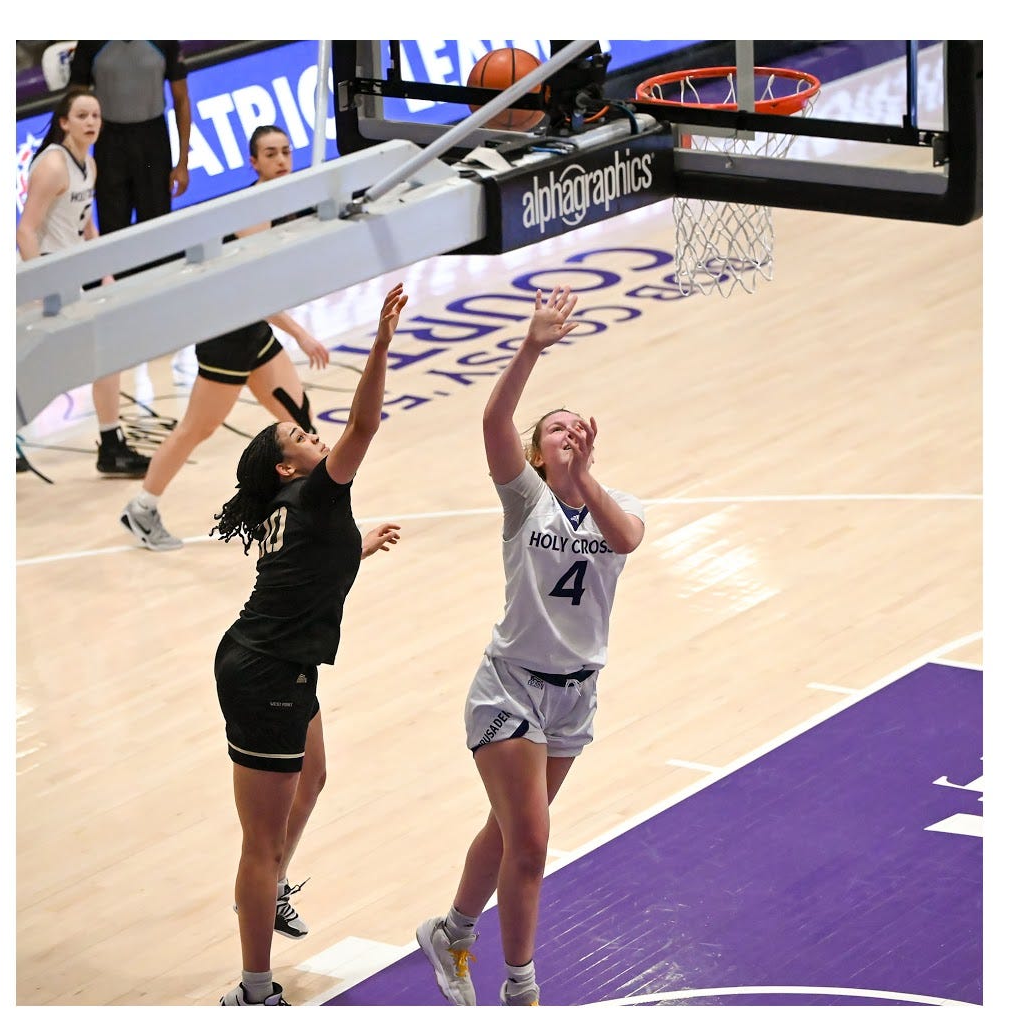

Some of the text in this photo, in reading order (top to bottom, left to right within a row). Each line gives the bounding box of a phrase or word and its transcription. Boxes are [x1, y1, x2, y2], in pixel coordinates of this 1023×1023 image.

[522, 148, 653, 234] alphagraphics
[529, 531, 614, 554] HOLY CROS
[548, 560, 588, 606] 4
